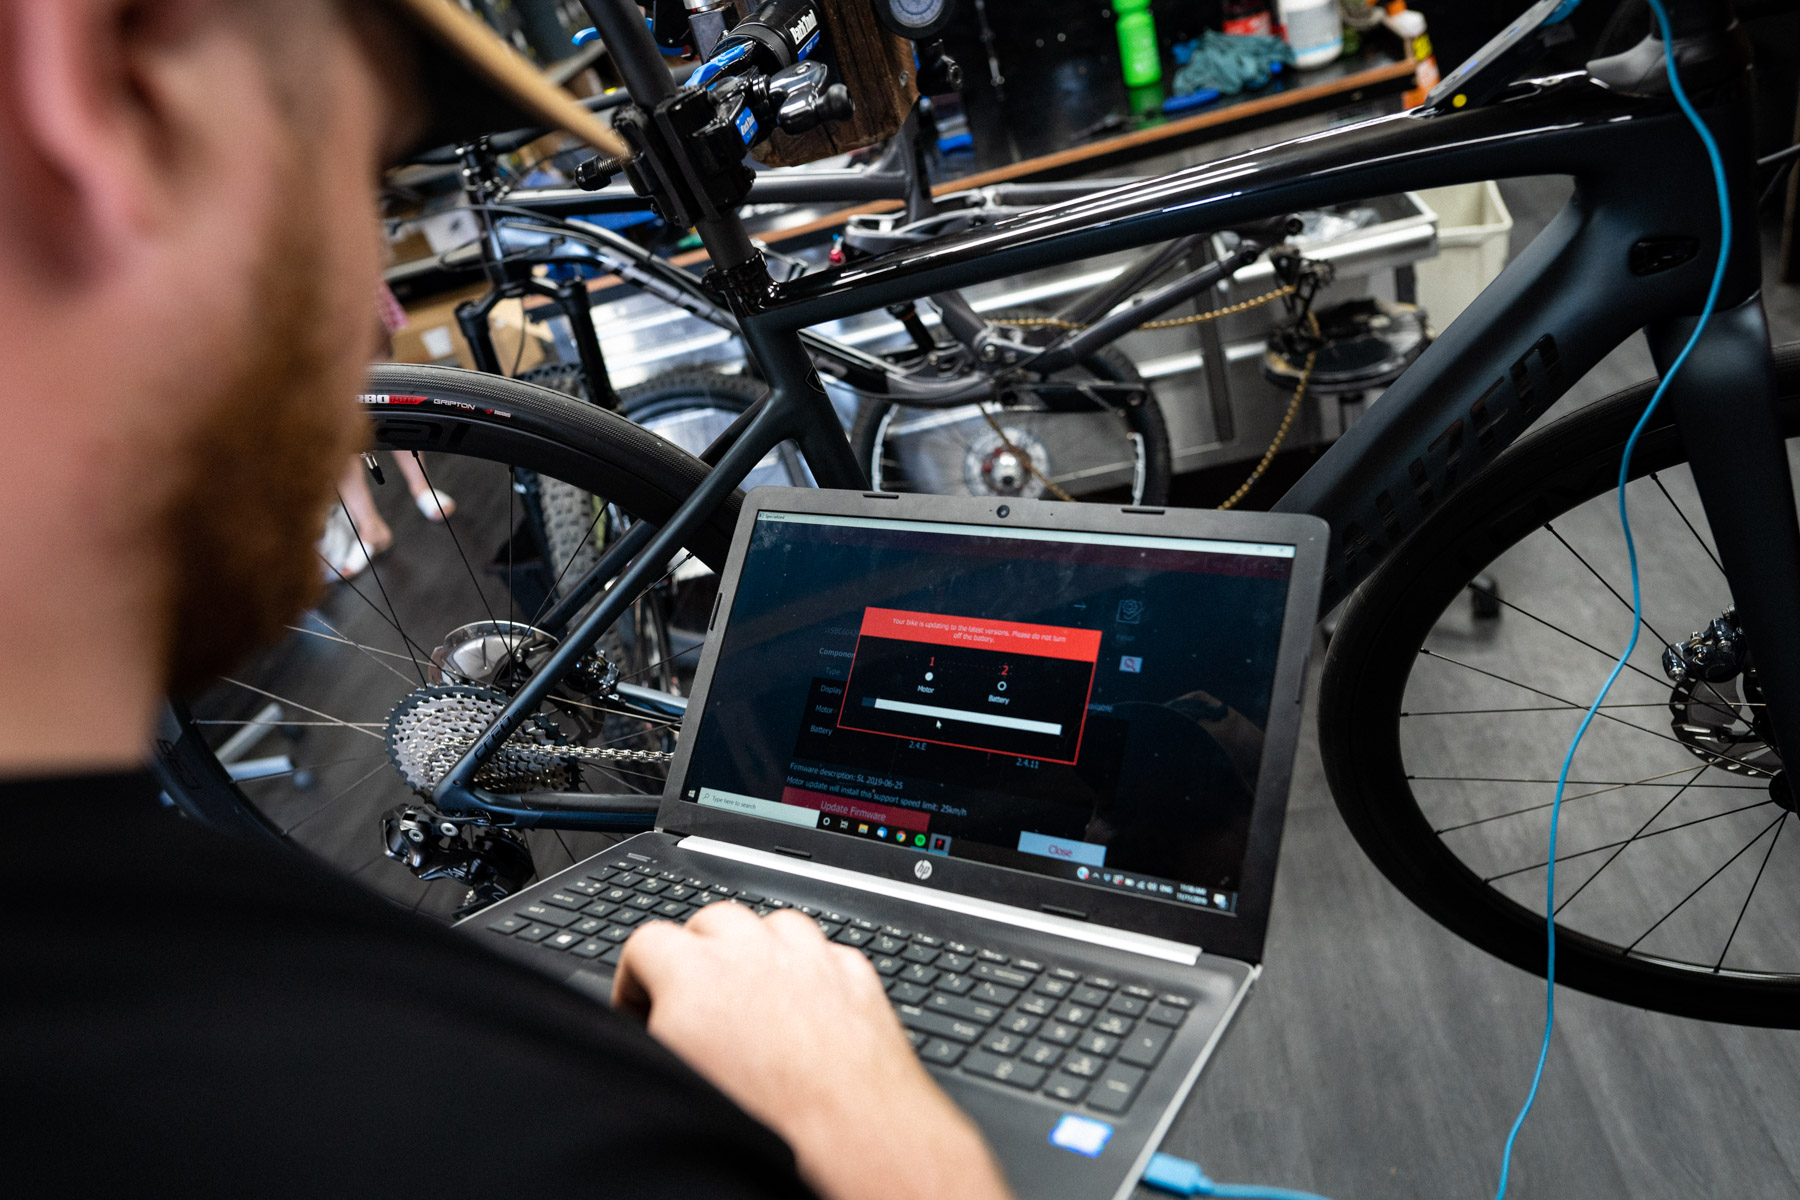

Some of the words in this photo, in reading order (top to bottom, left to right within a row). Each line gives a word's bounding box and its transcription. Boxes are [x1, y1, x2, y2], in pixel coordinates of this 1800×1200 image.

[433, 399, 475, 410] GRIPTON
[925, 622, 949, 631] updating
[958, 624, 968, 632] the
[968, 626, 984, 634] latest
[1012, 630, 1030, 639] Please
[973, 634, 995, 644] battery.
[819, 648, 855, 658] Componen
[930, 657, 935, 666] 1
[1001, 665, 1009, 676] 2
[820, 684, 842, 695] Display
[917, 685, 935, 694] Motor
[988, 694, 1010, 705] Battery
[816, 704, 833, 714] Motor
[810, 725, 832, 736] Battery
[790, 762, 818, 774] Firmware
[820, 768, 856, 781] description:
[856, 774, 865, 783] SL
[866, 776, 903, 790] 2019-06-25
[786, 776, 804, 786] Motor
[805, 780, 828, 790] update
[829, 784, 840, 792] will
[840, 785, 860, 796] install
[860, 789, 872, 798] this
[874, 791, 899, 804] support
[900, 797, 920, 808] speed
[922, 801, 937, 811] limit:
[940, 804, 967, 816] 25km/h
[712, 796, 723, 804] Type
[741, 801, 756, 810] search
[820, 801, 849, 815] Update
[850, 806, 886, 821] Firmware
[1048, 845, 1072, 857] Close
